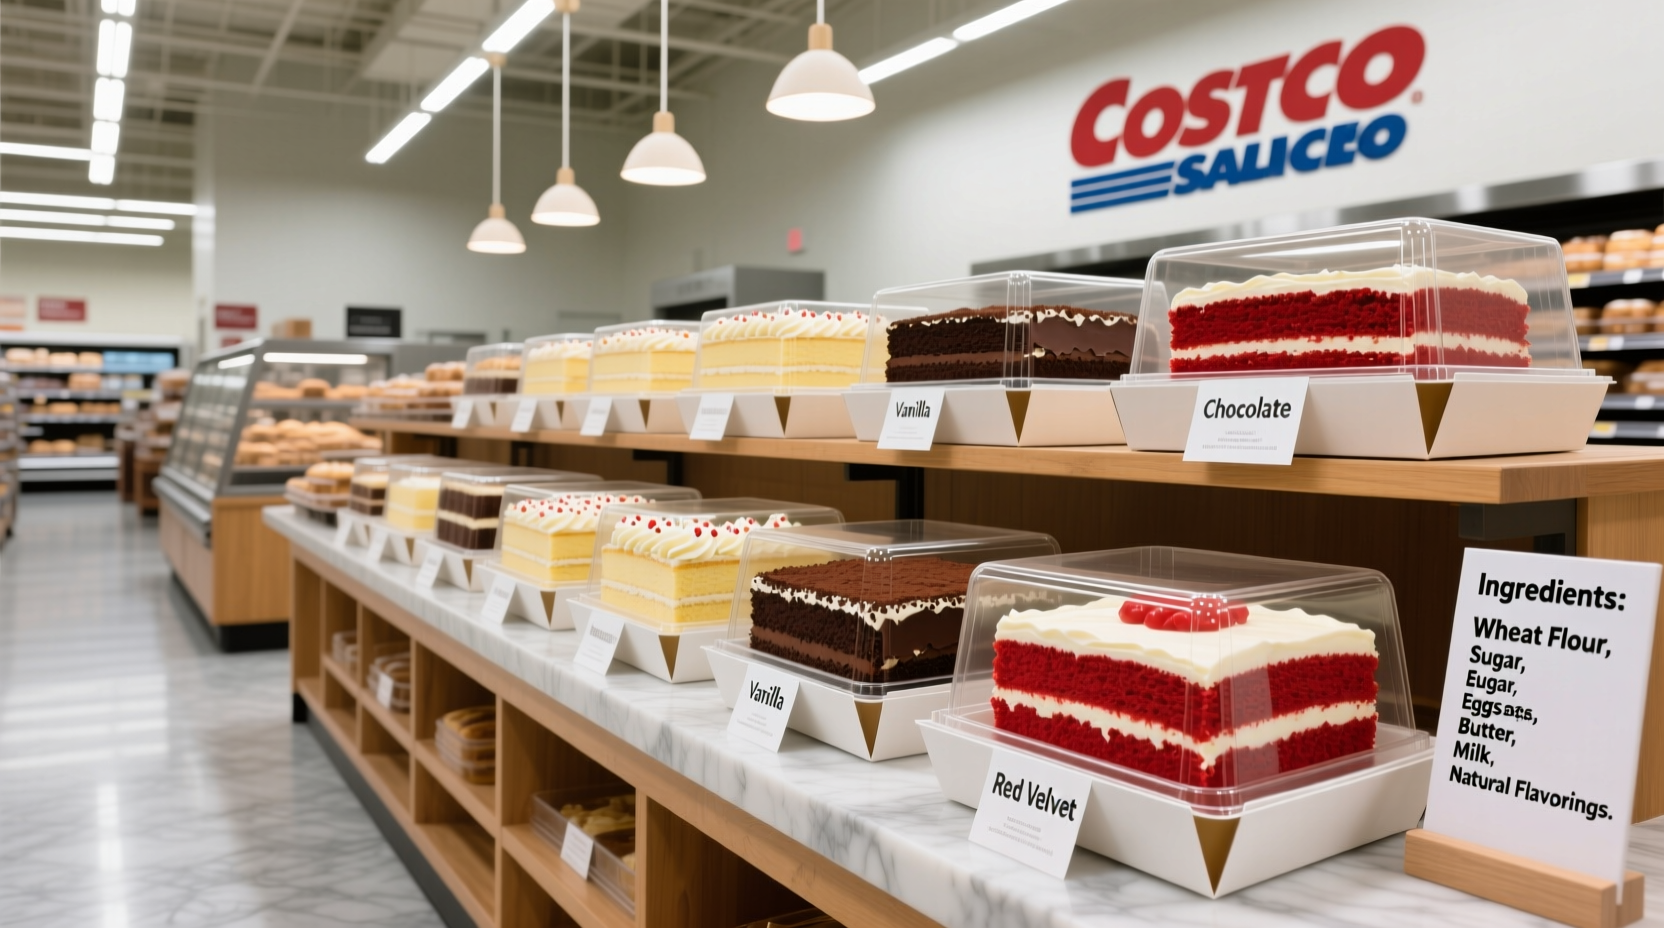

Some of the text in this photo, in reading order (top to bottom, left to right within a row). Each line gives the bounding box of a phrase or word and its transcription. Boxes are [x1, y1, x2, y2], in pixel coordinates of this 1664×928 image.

[1070, 25, 1426, 168] COSTCO
[1173, 114, 1407, 195] SALICEO
[896, 400, 931, 418] Vanilla
[1203, 396, 1292, 419] Chocolate
[1478, 572, 1627, 612] Ingredients:
[1473, 616, 1612, 659] Wheat Flour,
[1469, 644, 1526, 675] Sugar,
[749, 680, 785, 711] Vanilla
[1465, 669, 1518, 697] Eugar,
[1457, 716, 1516, 748] Butter,
[1453, 740, 1495, 768] Milk,
[992, 771, 1077, 822] Red Velvet
[1449, 765, 1613, 821] Natural Flavorings.
